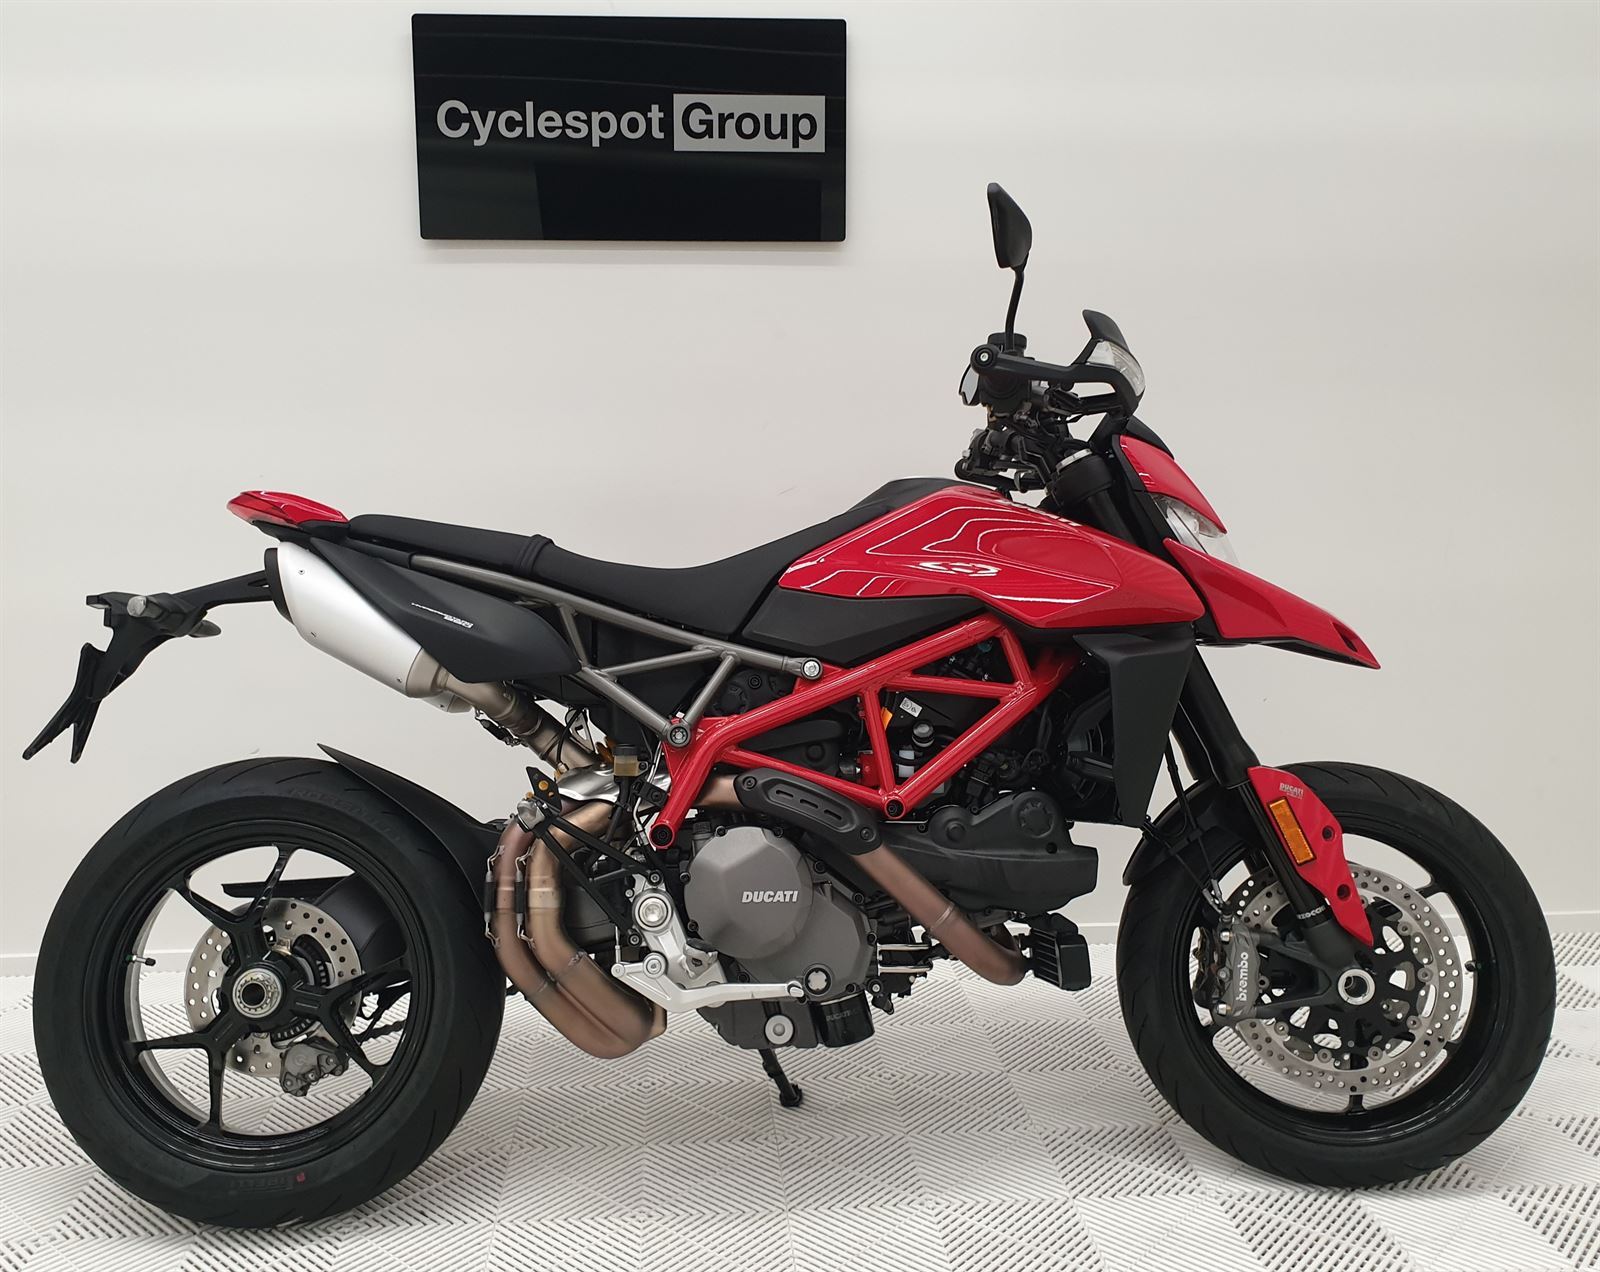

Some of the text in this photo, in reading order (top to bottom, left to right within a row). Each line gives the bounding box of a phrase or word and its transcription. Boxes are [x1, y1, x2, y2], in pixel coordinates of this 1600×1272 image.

[437, 100, 818, 148] Cyclespot Group
[741, 890, 799, 903] DUCATI
[1236, 952, 1249, 1001] brembo
